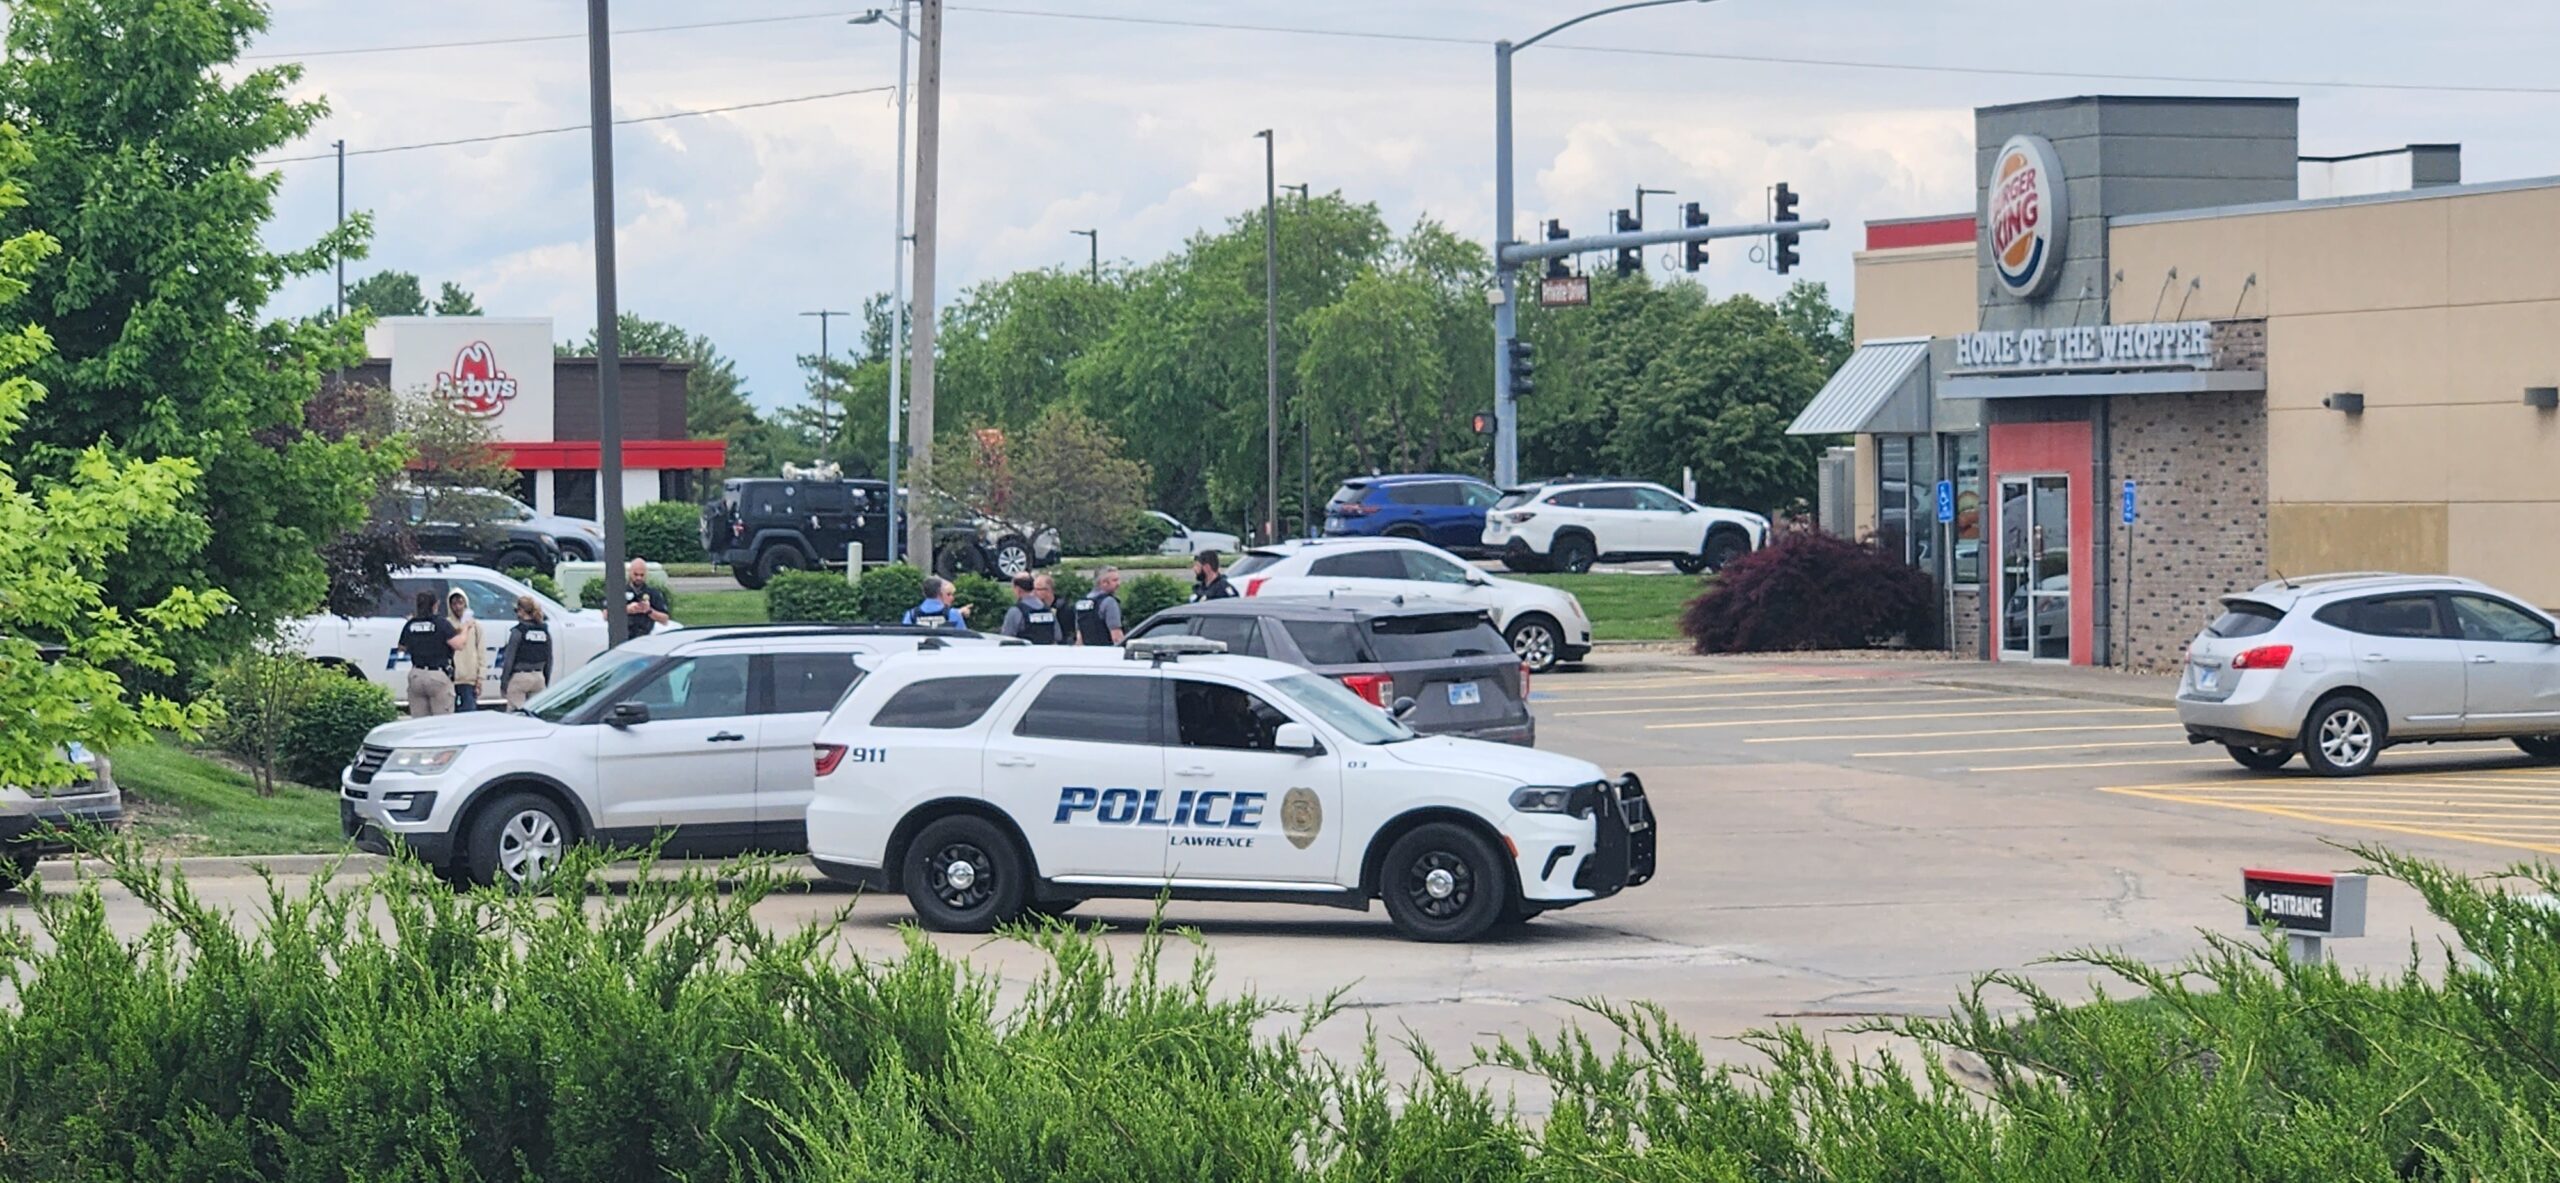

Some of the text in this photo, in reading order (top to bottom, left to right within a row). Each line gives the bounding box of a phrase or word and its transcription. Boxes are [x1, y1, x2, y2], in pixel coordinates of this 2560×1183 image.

[1994, 168, 2037, 222] RGER
[1995, 192, 2039, 258] KING
[1956, 322, 2212, 365] HOME OF THE WHOPPER
[433, 371, 517, 404] Arby's
[852, 747, 886, 763] 911
[1053, 787, 1267, 829] POLICE
[1170, 835, 1254, 848] LAWRENCE
[2271, 893, 2323, 918] ENTRANCE
